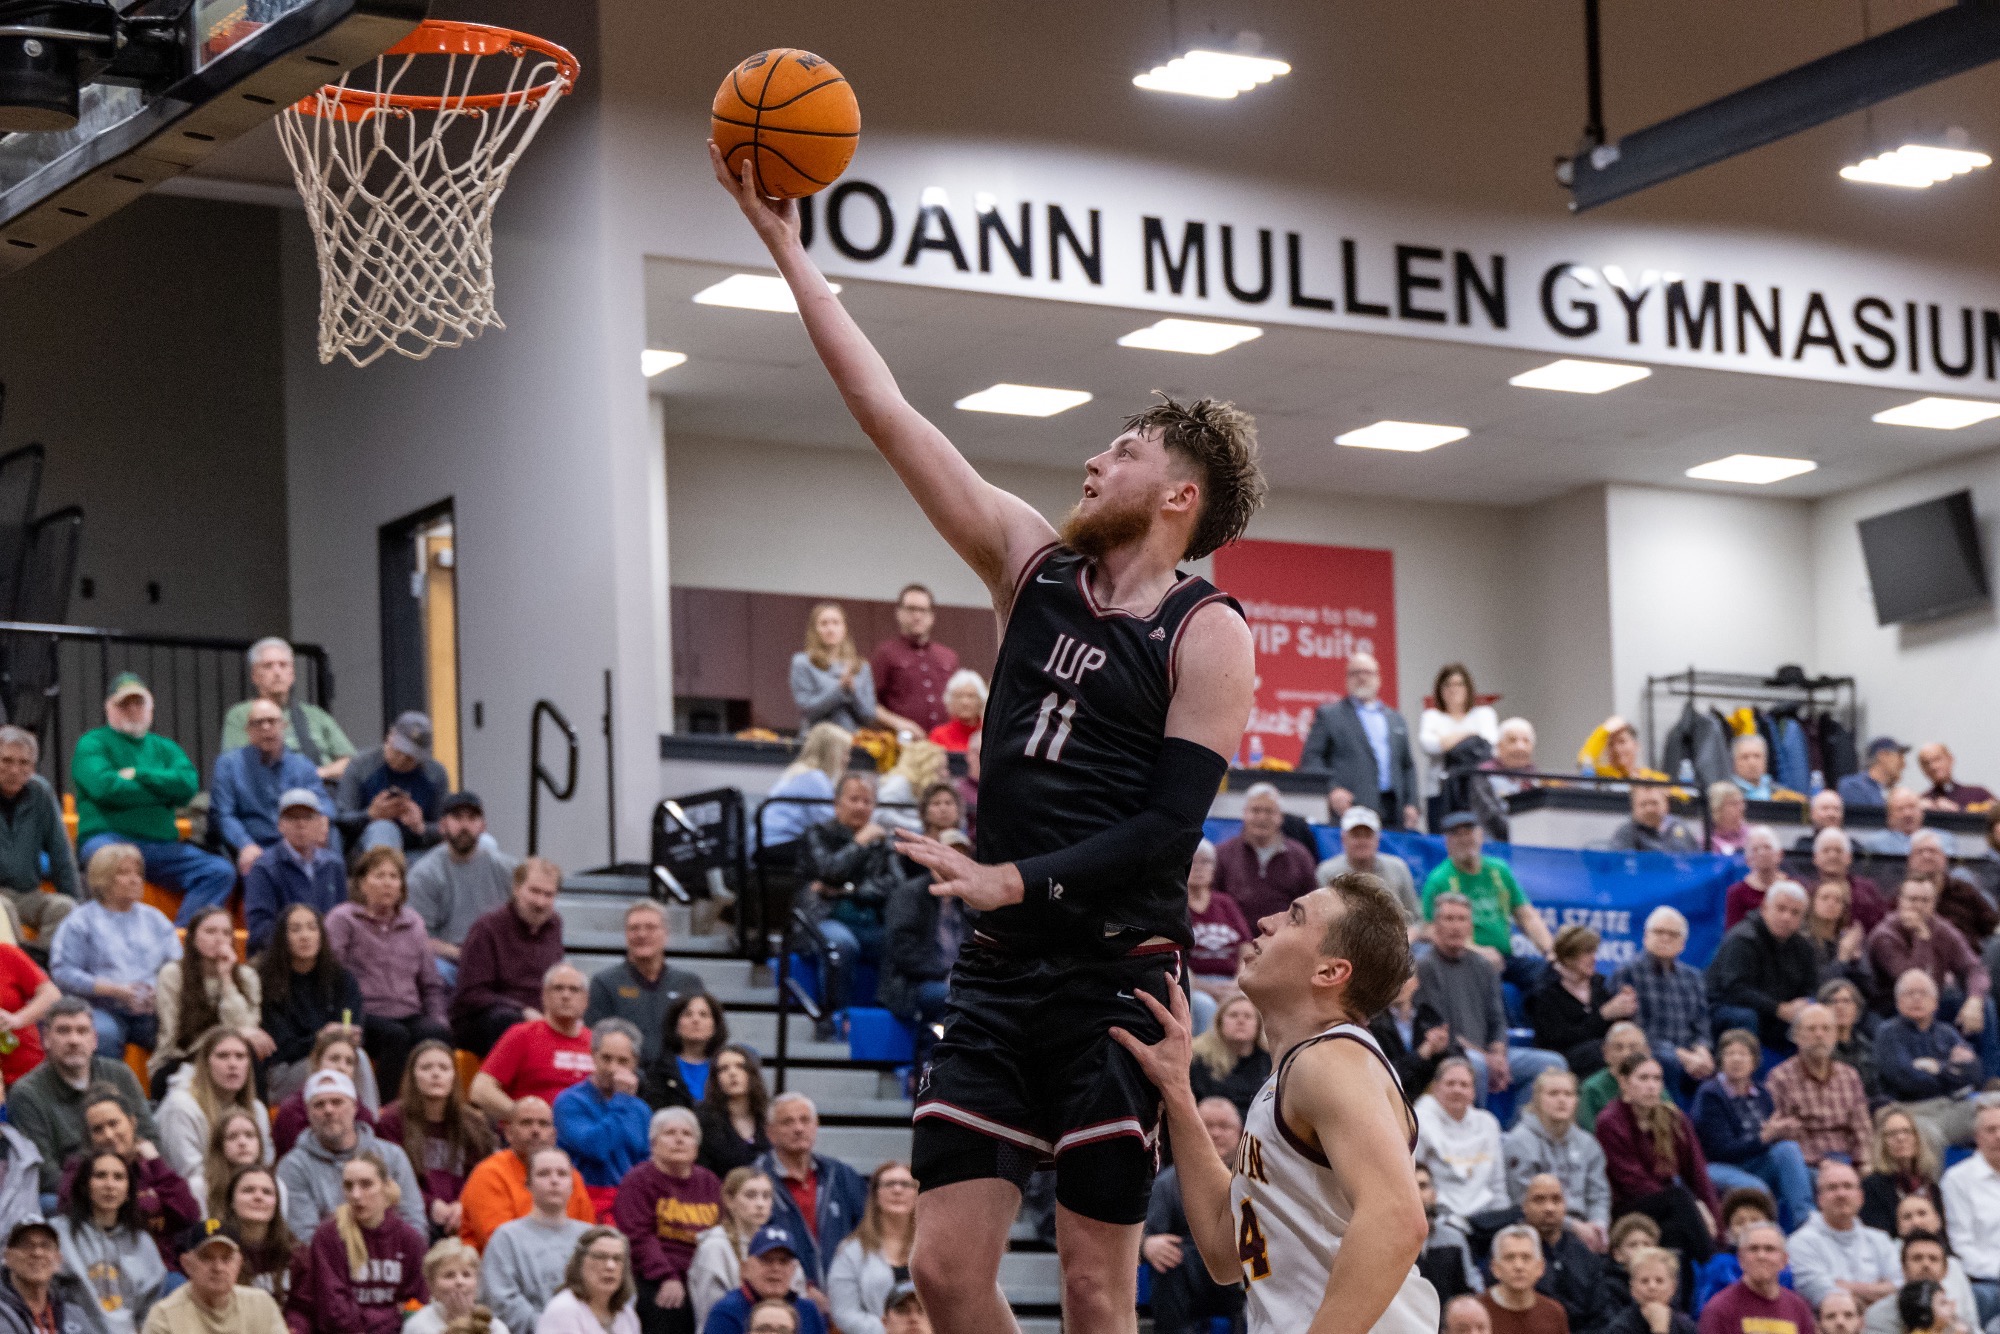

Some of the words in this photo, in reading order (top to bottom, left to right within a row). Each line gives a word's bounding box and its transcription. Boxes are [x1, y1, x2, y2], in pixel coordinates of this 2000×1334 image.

[1142, 215, 1508, 331] MULLEN
[1043, 633, 1107, 685] IUP
[1024, 691, 1077, 762] 11
[1234, 1196, 1272, 1290] 4
